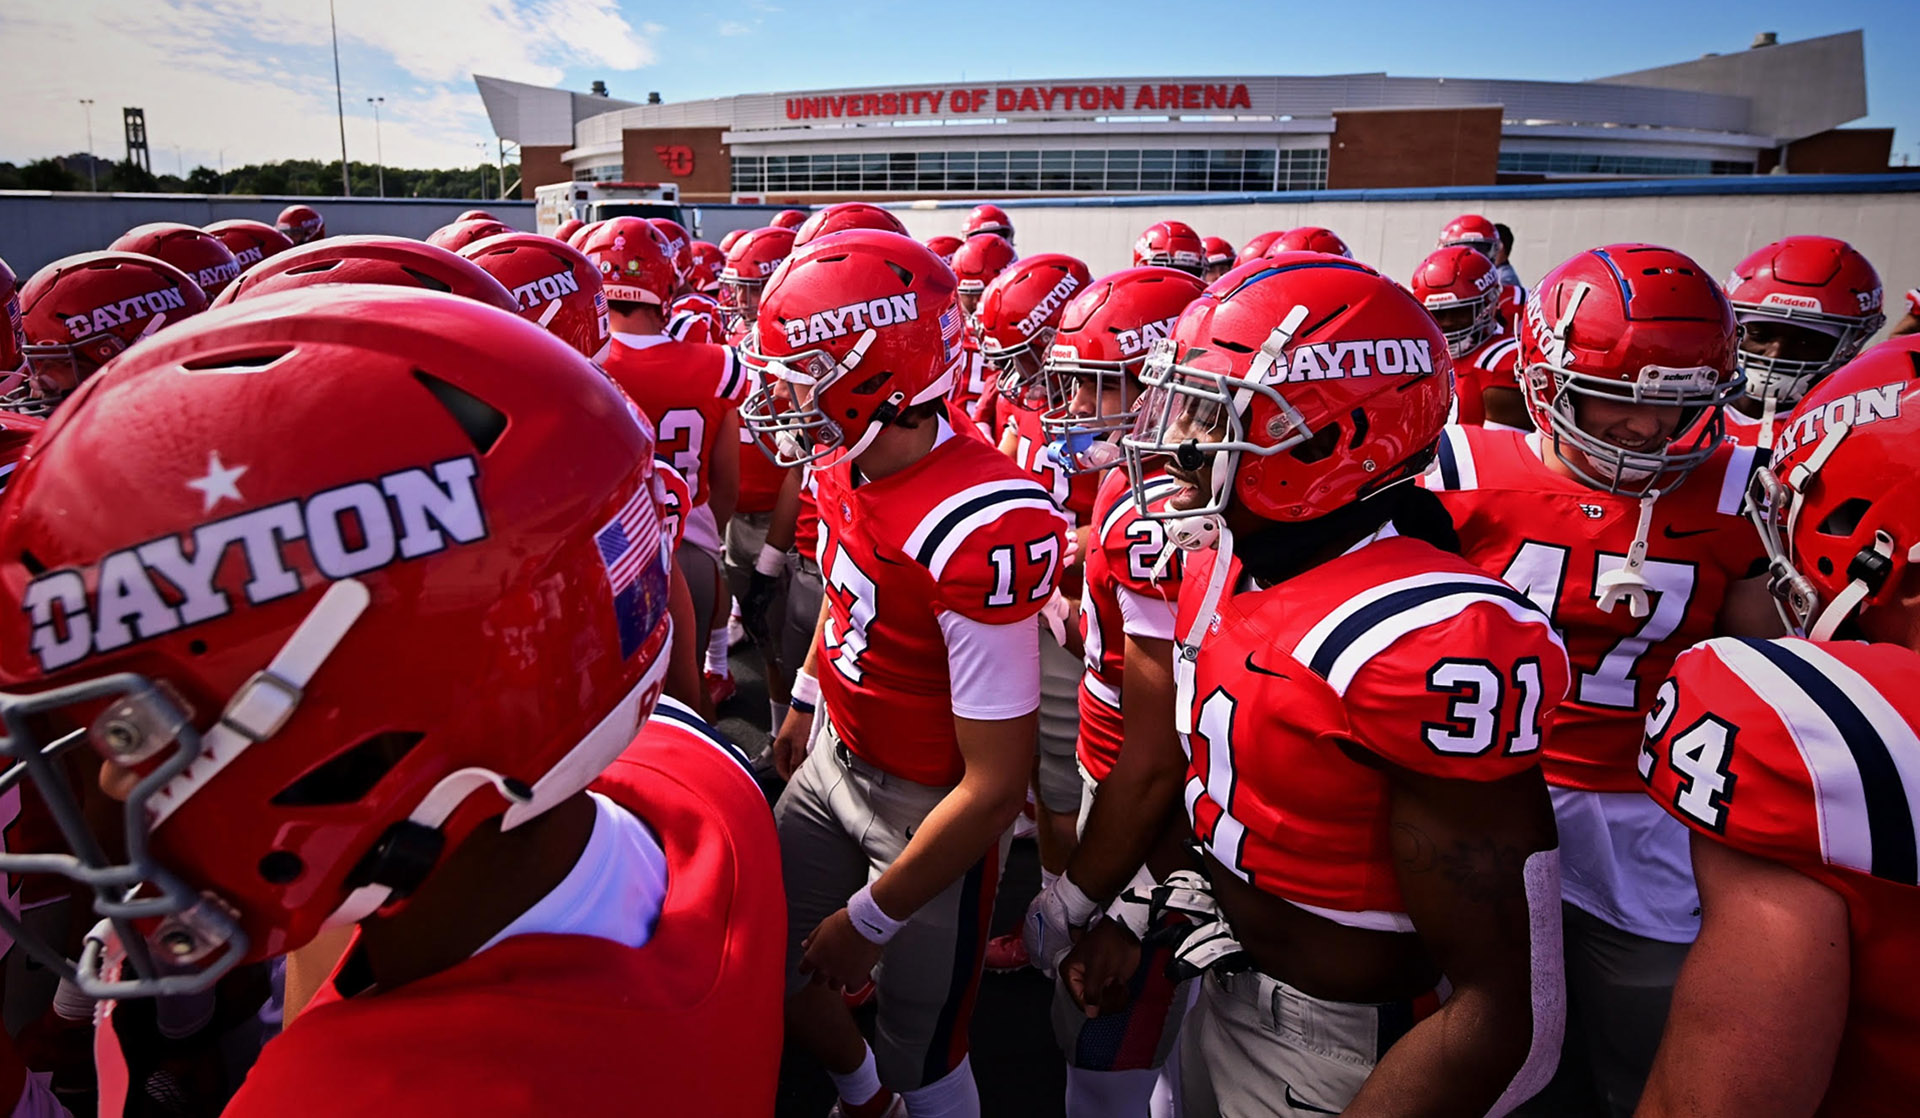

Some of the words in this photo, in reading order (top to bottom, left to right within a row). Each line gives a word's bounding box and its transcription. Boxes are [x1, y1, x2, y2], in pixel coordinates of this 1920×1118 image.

[786, 90, 944, 120] UNIVERSITY
[949, 89, 989, 113] OF
[995, 85, 1125, 113] DAYTON
[1133, 84, 1252, 110] ARENA
[64, 286, 186, 339] DAYTON
[606, 288, 642, 299] ddell
[784, 291, 919, 349] DAYTON
[1016, 272, 1080, 337] DAYTON
[1770, 295, 1817, 309] Riddell
[1663, 373, 1693, 381] schutt
[1769, 381, 1906, 468] AYTON
[25, 456, 488, 674] DAYTON
[984, 530, 1061, 608] 17
[1501, 538, 1699, 712] 47
[1420, 655, 1546, 758] 31
[1638, 675, 1741, 837] 24
